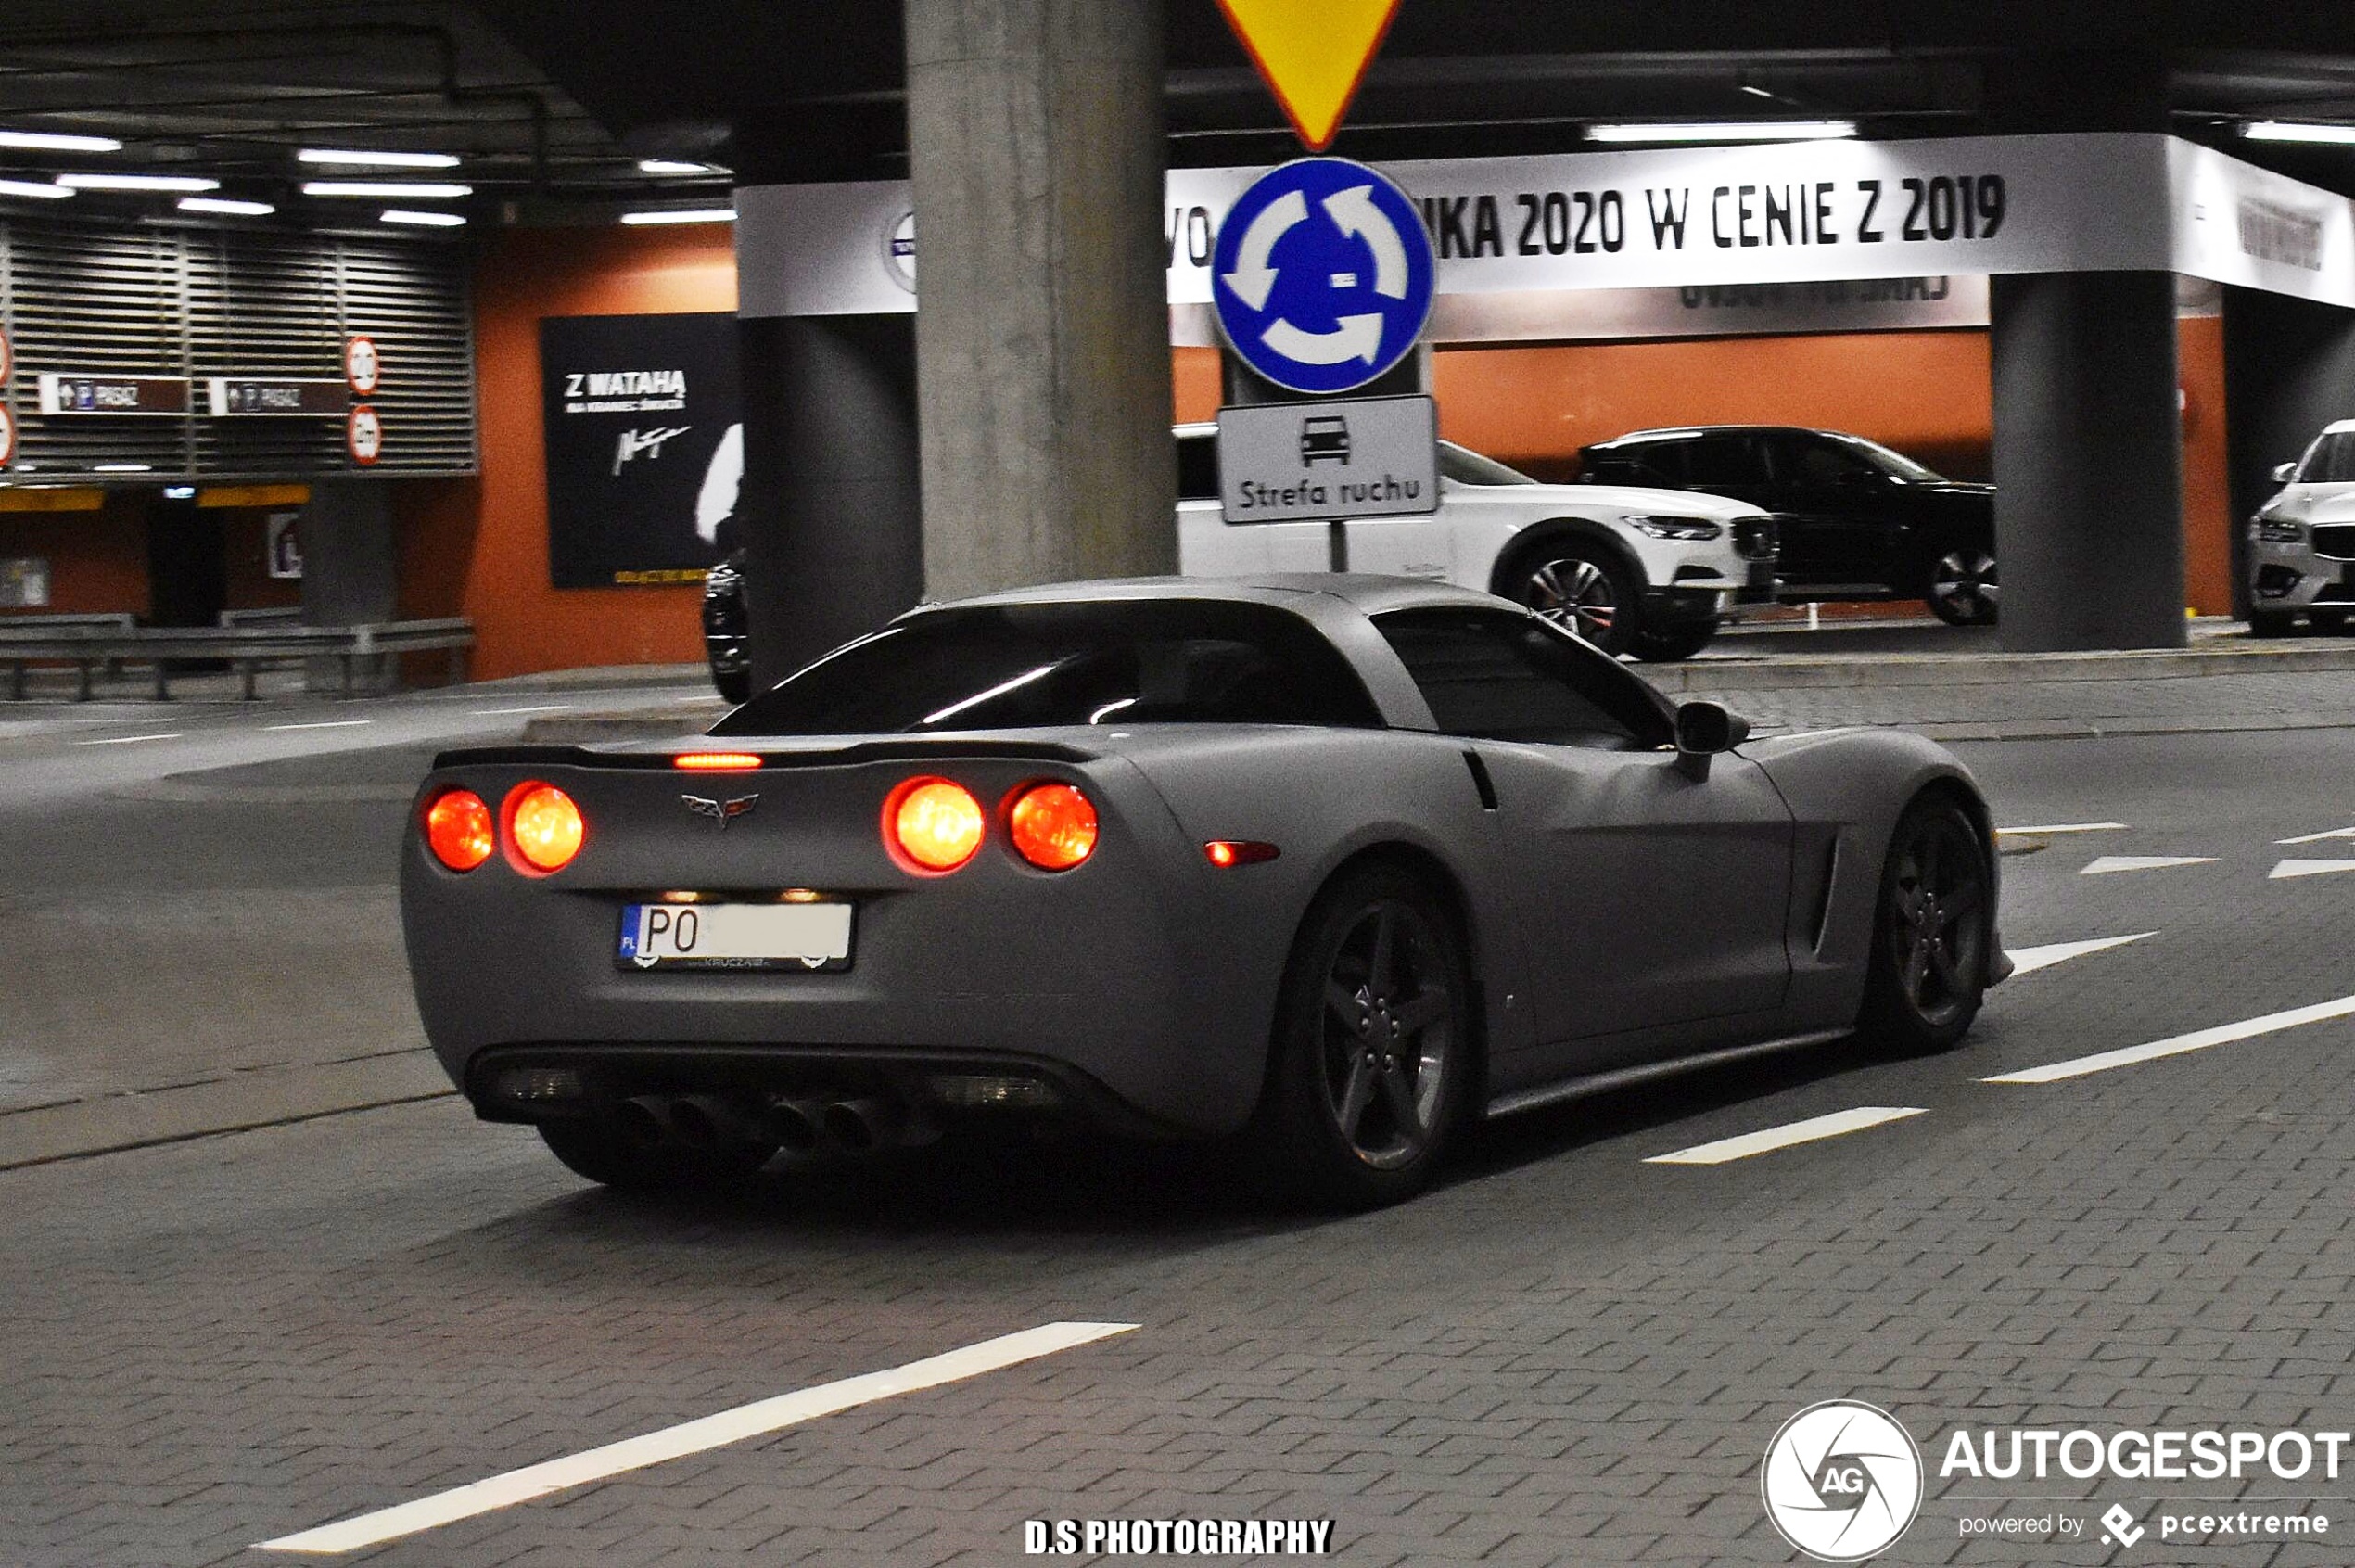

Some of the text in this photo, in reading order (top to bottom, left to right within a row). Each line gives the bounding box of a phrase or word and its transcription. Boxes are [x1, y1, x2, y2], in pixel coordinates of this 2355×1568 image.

[1517, 189, 1623, 256] 2020
[1645, 188, 1689, 250] W
[1712, 183, 1839, 248] CENIE
[1857, 180, 1884, 243] Z
[1902, 174, 2005, 242] 2019
[564, 374, 585, 397] Z
[1239, 474, 1419, 508] Strefa ruchu
[623, 909, 698, 952] PL PO
